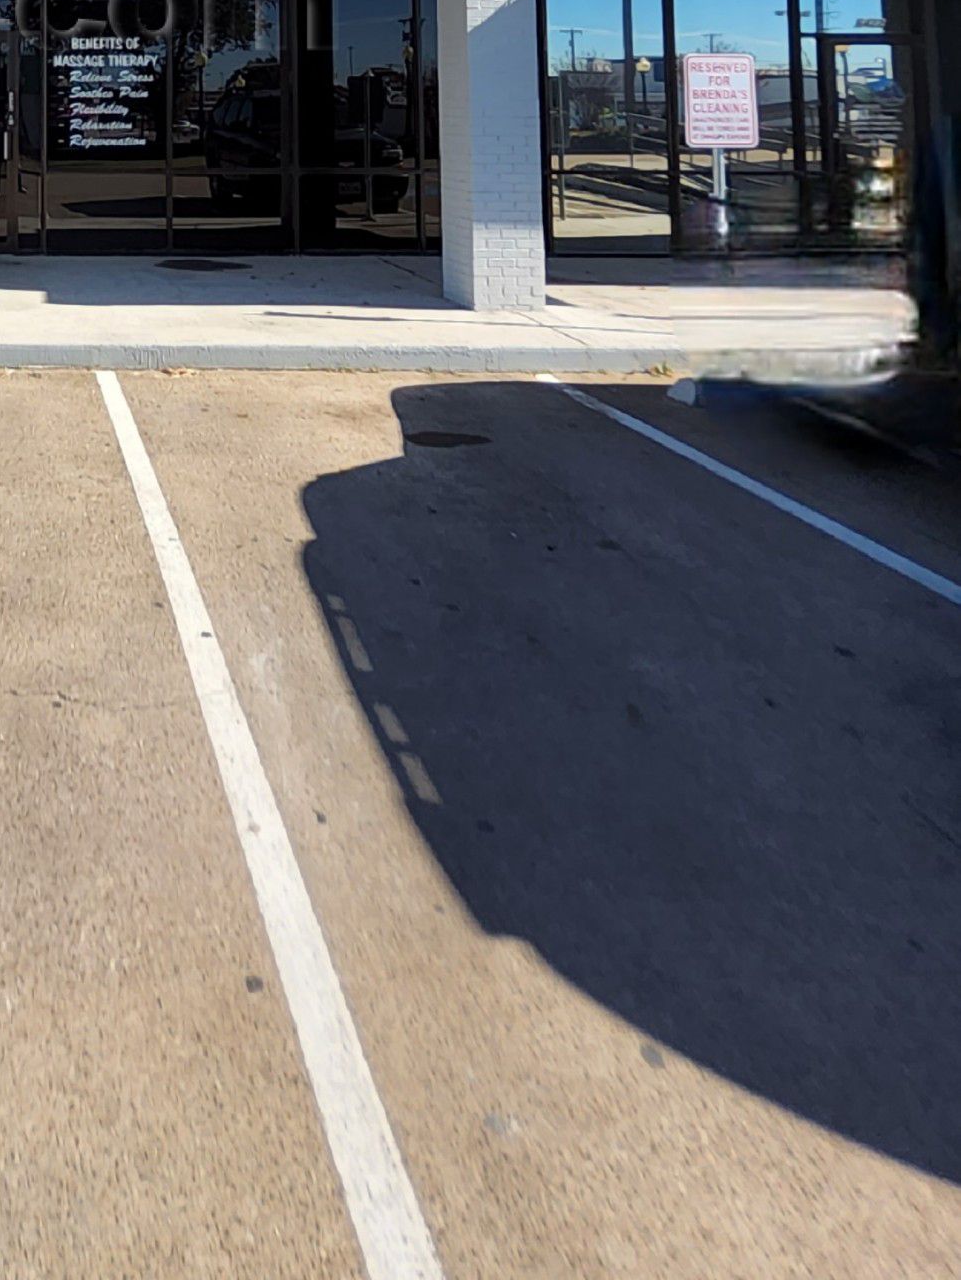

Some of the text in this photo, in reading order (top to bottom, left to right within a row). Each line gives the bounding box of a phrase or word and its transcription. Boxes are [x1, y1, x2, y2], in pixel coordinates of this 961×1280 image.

[71, 37, 141, 50] BENEFITS OF
[52, 54, 159, 68] MASSAGE THERAPY
[690, 62, 748, 73] RESERVED
[117, 70, 155, 82] Stress
[708, 75, 731, 87] FOR
[692, 89, 749, 100] BRENDA'S
[692, 103, 750, 114] CLEANING
